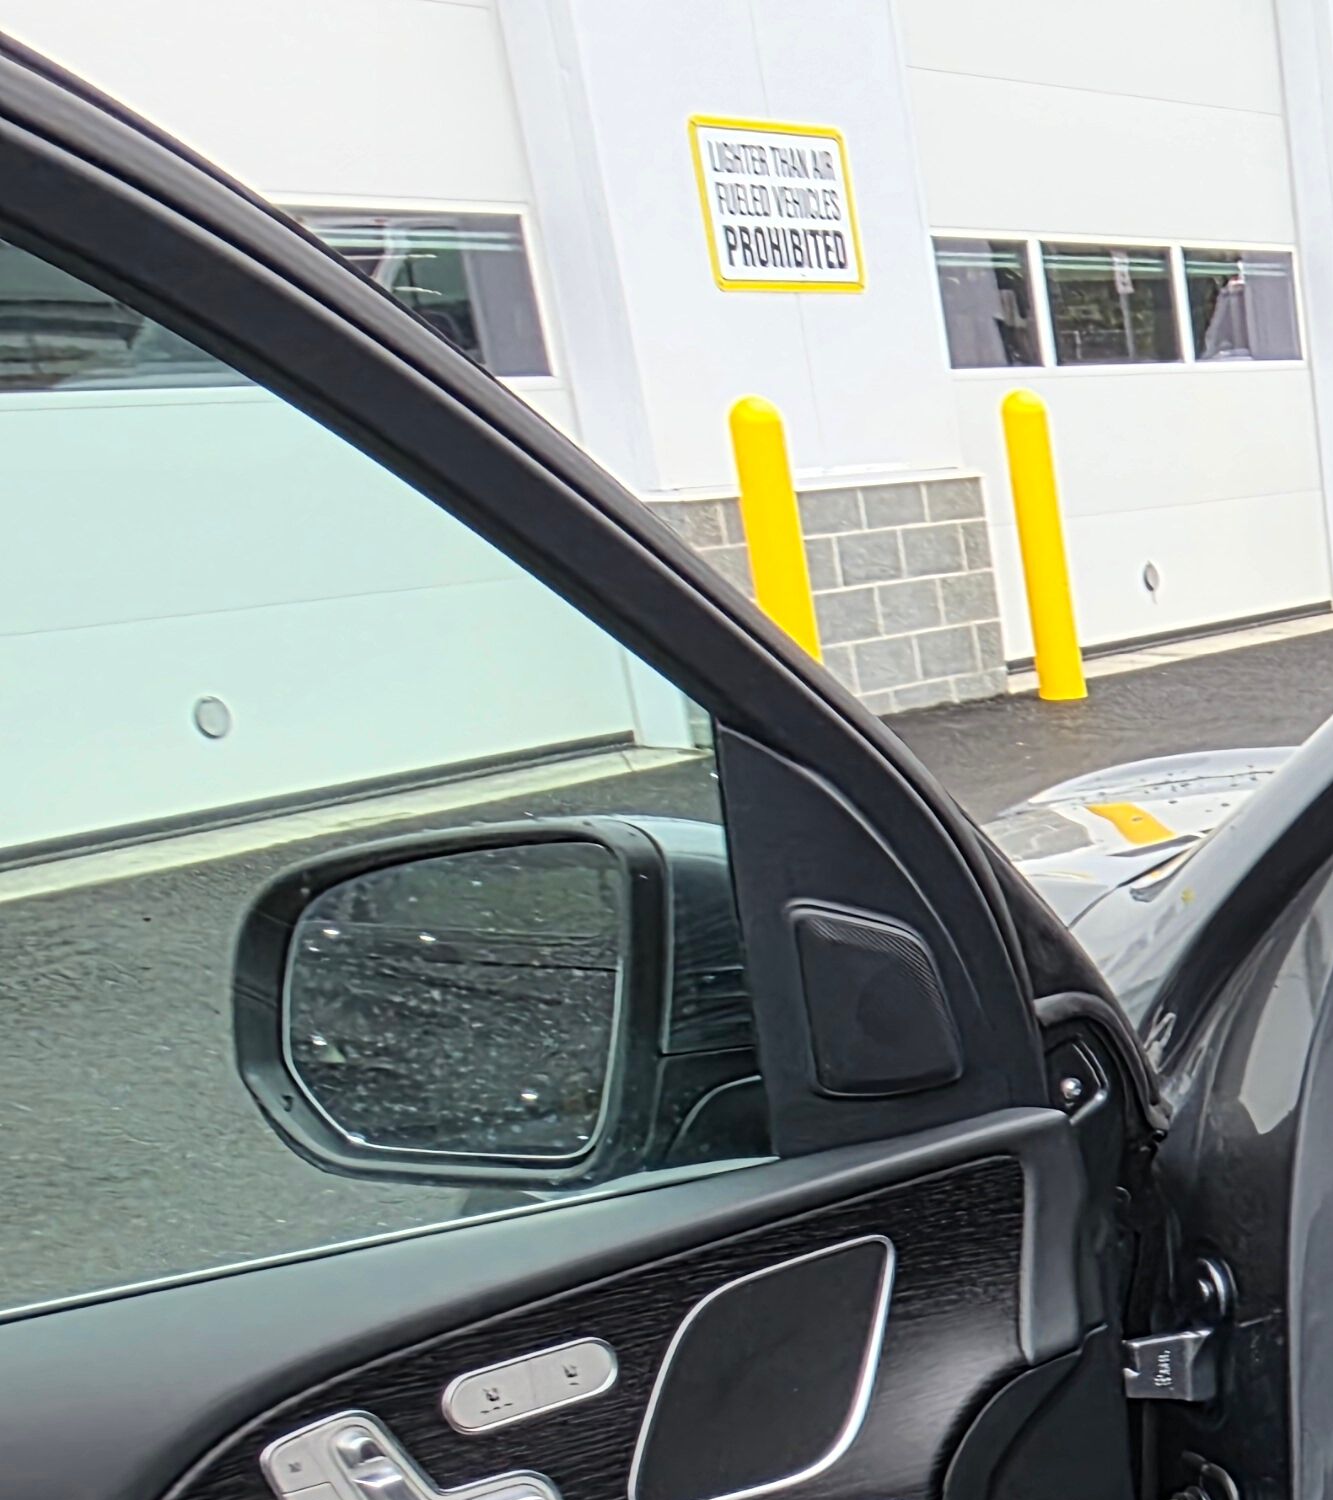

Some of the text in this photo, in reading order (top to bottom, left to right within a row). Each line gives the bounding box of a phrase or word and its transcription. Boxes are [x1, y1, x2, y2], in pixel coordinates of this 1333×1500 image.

[707, 140, 837, 181] LIGHTER THAN AIR
[715, 181, 842, 221] FUELED VEHICLES
[722, 224, 848, 269] PROHIBITED
